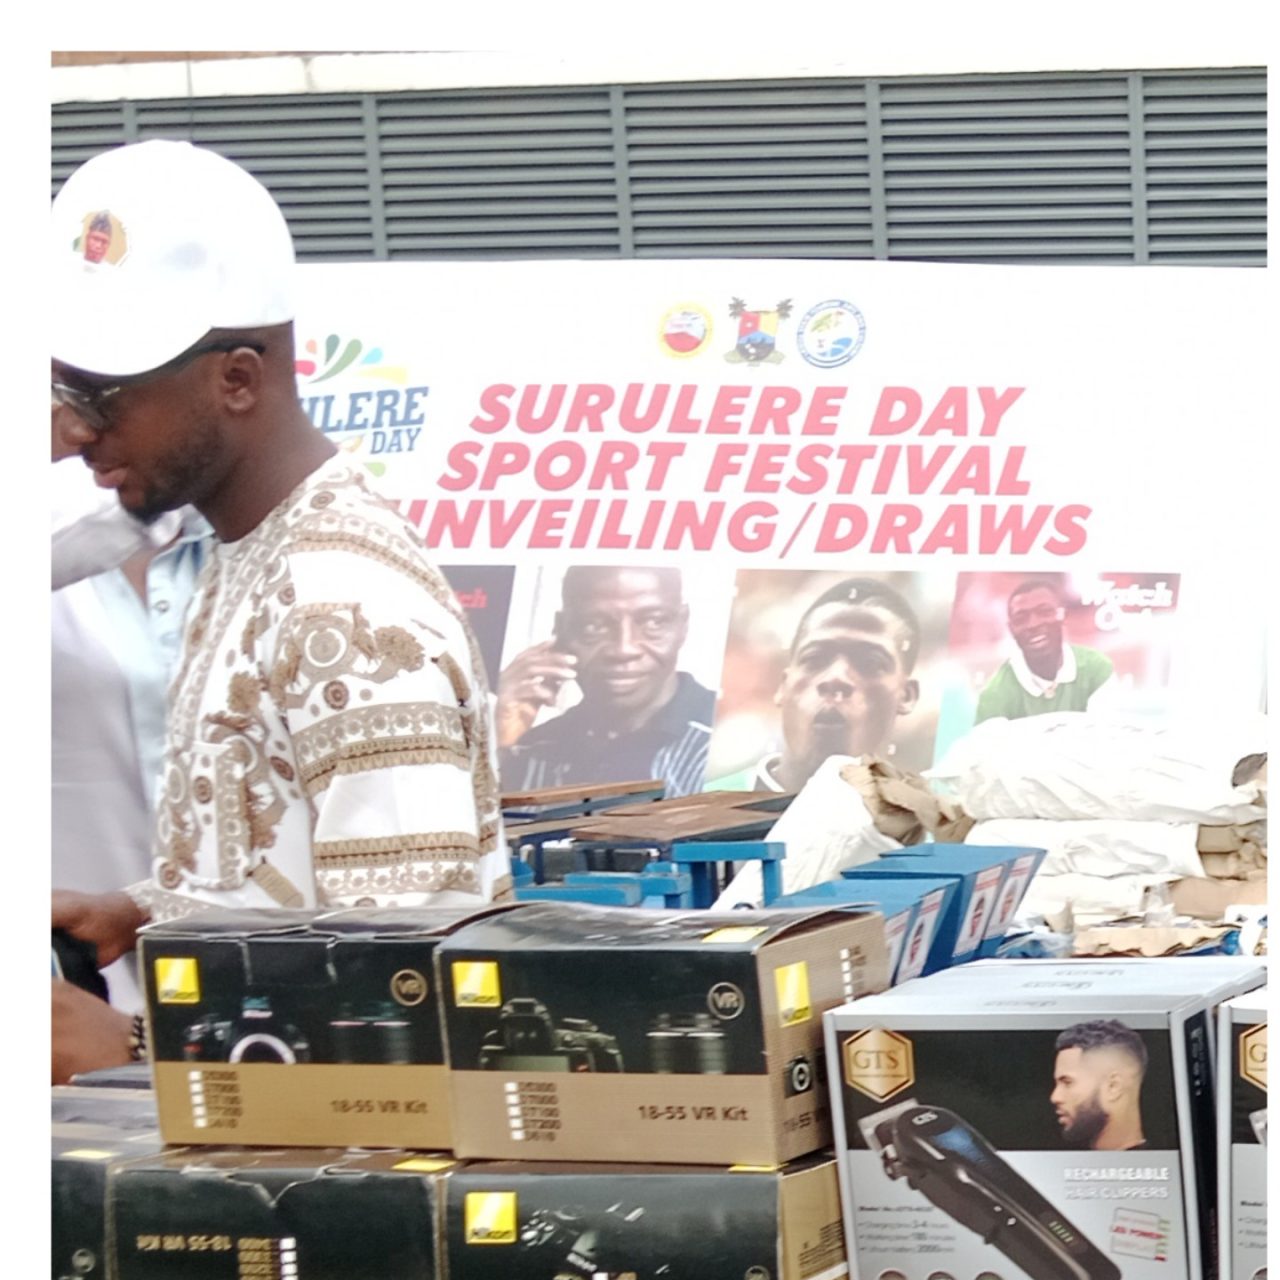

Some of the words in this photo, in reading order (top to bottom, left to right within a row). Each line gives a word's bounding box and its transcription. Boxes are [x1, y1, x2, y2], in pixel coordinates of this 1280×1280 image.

[469, 383, 847, 437] SURULERE
[868, 386, 1026, 437] DAY
[371, 428, 422, 455] DAY
[436, 440, 687, 493] SPORT
[703, 443, 1031, 496] FESTIVAL
[854, 1049, 900, 1070] GTS
[331, 1100, 374, 1114] 18-55
[378, 1100, 401, 1114] VR
[405, 1100, 429, 1114] Kit
[638, 1105, 687, 1121] 18-55
[692, 1105, 716, 1121] VR
[721, 1105, 749, 1121] Kit
[1064, 1167, 1169, 1181] RECHARGEABLE
